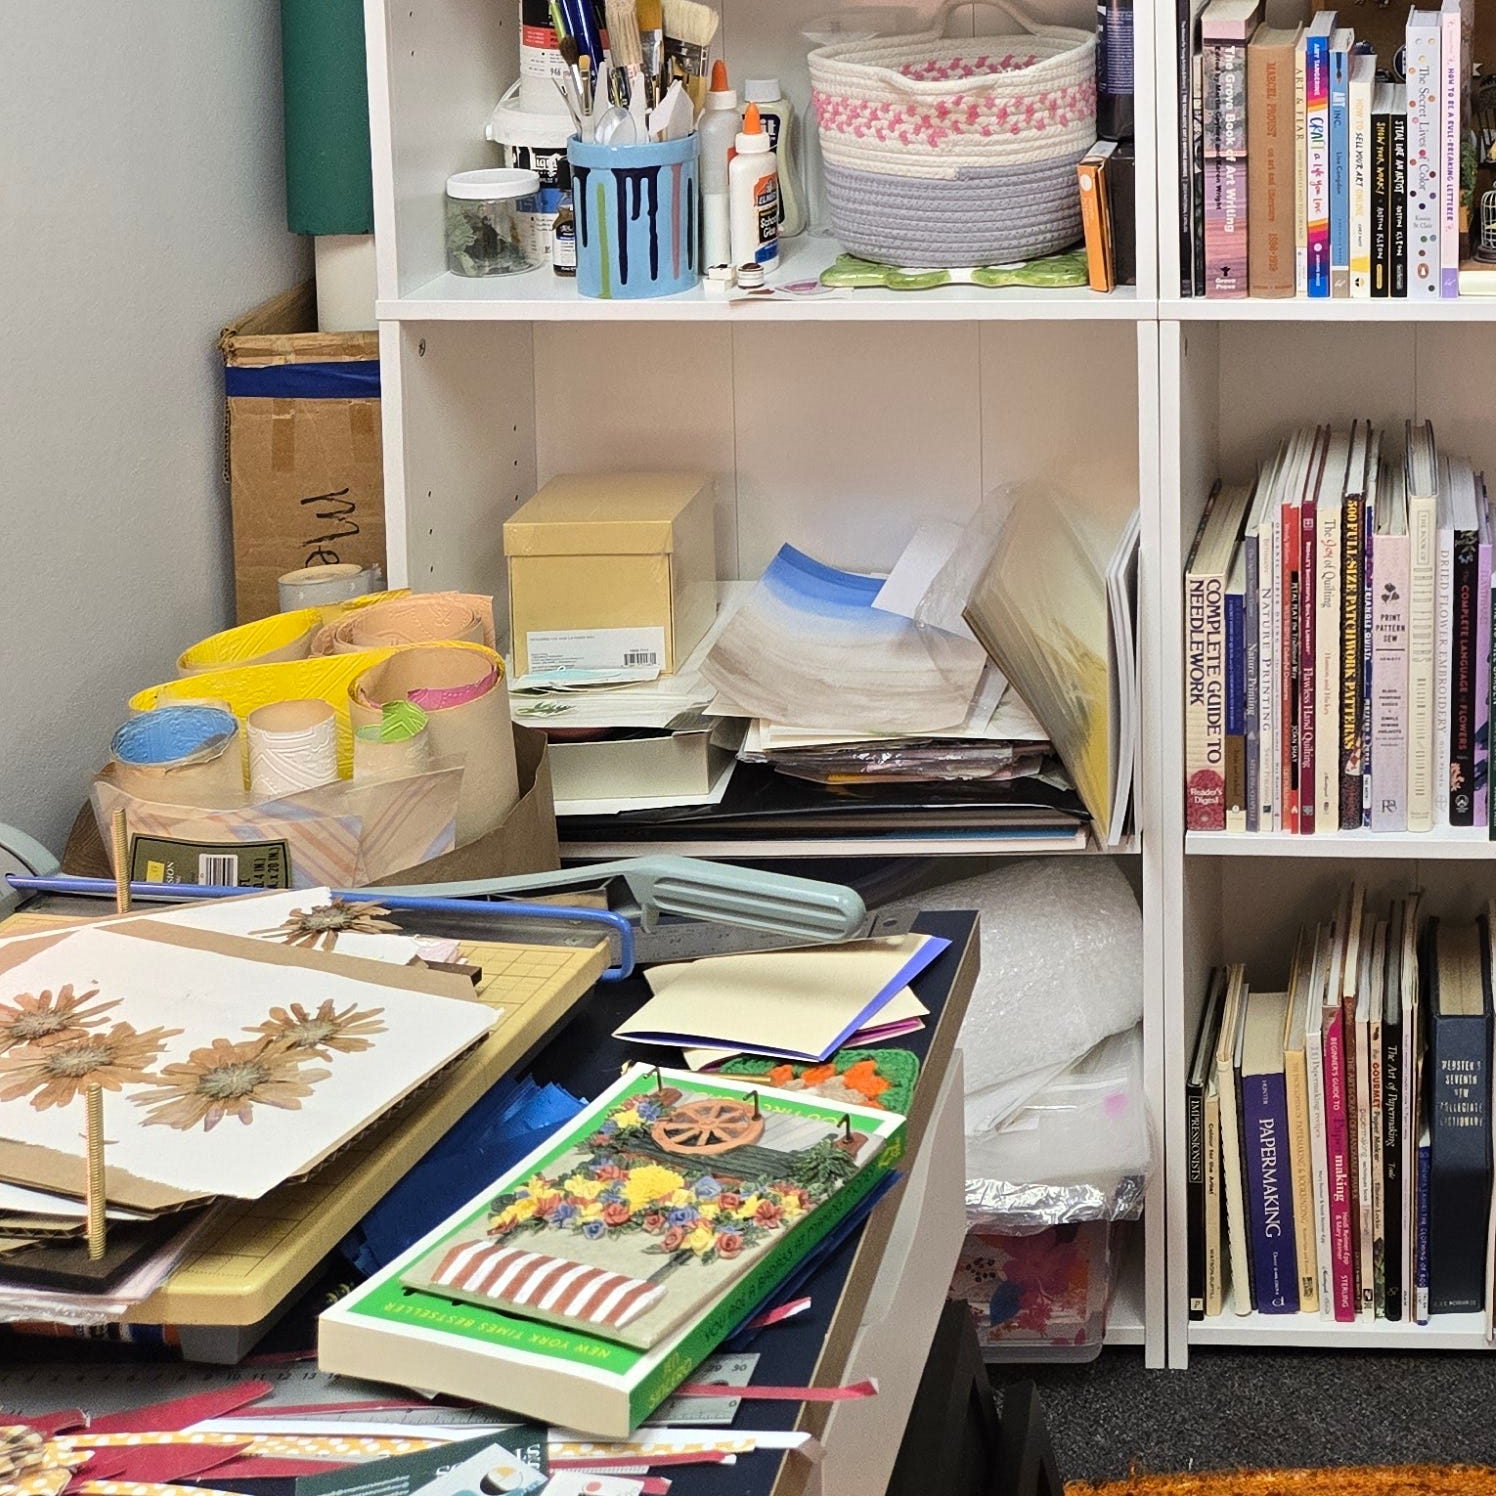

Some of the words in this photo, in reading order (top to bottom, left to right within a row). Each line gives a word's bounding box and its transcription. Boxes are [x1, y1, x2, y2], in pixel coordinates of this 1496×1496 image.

[1225, 45, 1236, 69] The
[1296, 68, 1304, 93] ART
[1418, 67, 1429, 84] The
[1447, 68, 1455, 84] HOW
[1225, 74, 1236, 110] Grove
[1418, 88, 1429, 117] Secret
[1225, 113, 1236, 144] Book
[1296, 111, 1304, 140] FEAR
[1419, 122, 1429, 147] Lives
[1225, 149, 1236, 161] of
[1355, 132, 1364, 149] SELL
[1355, 149, 1364, 169] YOUR
[1225, 165, 1236, 184] Art
[1356, 171, 1364, 187] ART
[1419, 164, 1430, 191] Color
[1223, 188, 1236, 233] Writing
[1346, 500, 1358, 521] 500
[1324, 519, 1335, 537] The
[1324, 560, 1336, 568] of
[1346, 523, 1358, 592] FULL-SIZE
[1439, 550, 1449, 589] DRIED
[1321, 571, 1336, 608] Quilting
[1262, 588, 1273, 649] NATURE
[1380, 614, 1401, 622] PRINT
[1438, 595, 1449, 645] FLOWER
[1459, 585, 1469, 636] COMPLETE
[1189, 579, 1205, 705] NEEDLEWORK
[1206, 579, 1222, 677] COMPLETE
[1345, 595, 1358, 678] PATCHWORK
[1376, 624, 1406, 633] PATTERN
[1383, 634, 1399, 643] SEW
[1247, 643, 1257, 676] Nature
[1459, 640, 1468, 692] LANGUAGE
[1246, 678, 1258, 715] Printing
[1262, 658, 1273, 732] PRINTING
[1303, 667, 1314, 703] Flawless
[1437, 651, 1448, 733] EMBROIDERY
[1206, 680, 1222, 736] GUIDE
[1303, 705, 1313, 725] Hand
[1345, 681, 1358, 750] PATTERNS
[1458, 705, 1468, 750] FLOWERS
[1206, 738, 1222, 765] TO
[1302, 728, 1313, 768] Quilting
[1388, 1046, 1398, 1061] The
[1372, 1063, 1381, 1109] GOURMET
[1388, 1064, 1398, 1079] Art
[1331, 1079, 1340, 1099] GUIDE
[1386, 1083, 1399, 1091] of
[1332, 1101, 1340, 1110] TO
[1386, 1093, 1398, 1147] Papermaking
[1190, 1101, 1201, 1181] IMPRESSIONISTS
[1259, 1118, 1281, 1238] PAPERMAKING
[1340, 1275, 1350, 1307] STERLING
[384, 1300, 476, 1332] BESTSELLER
[478, 1322, 524, 1344] TIMES
[532, 1333, 574, 1354] YORK
[579, 1343, 611, 1359] NEW
[302, 1372, 317, 1380] 13
